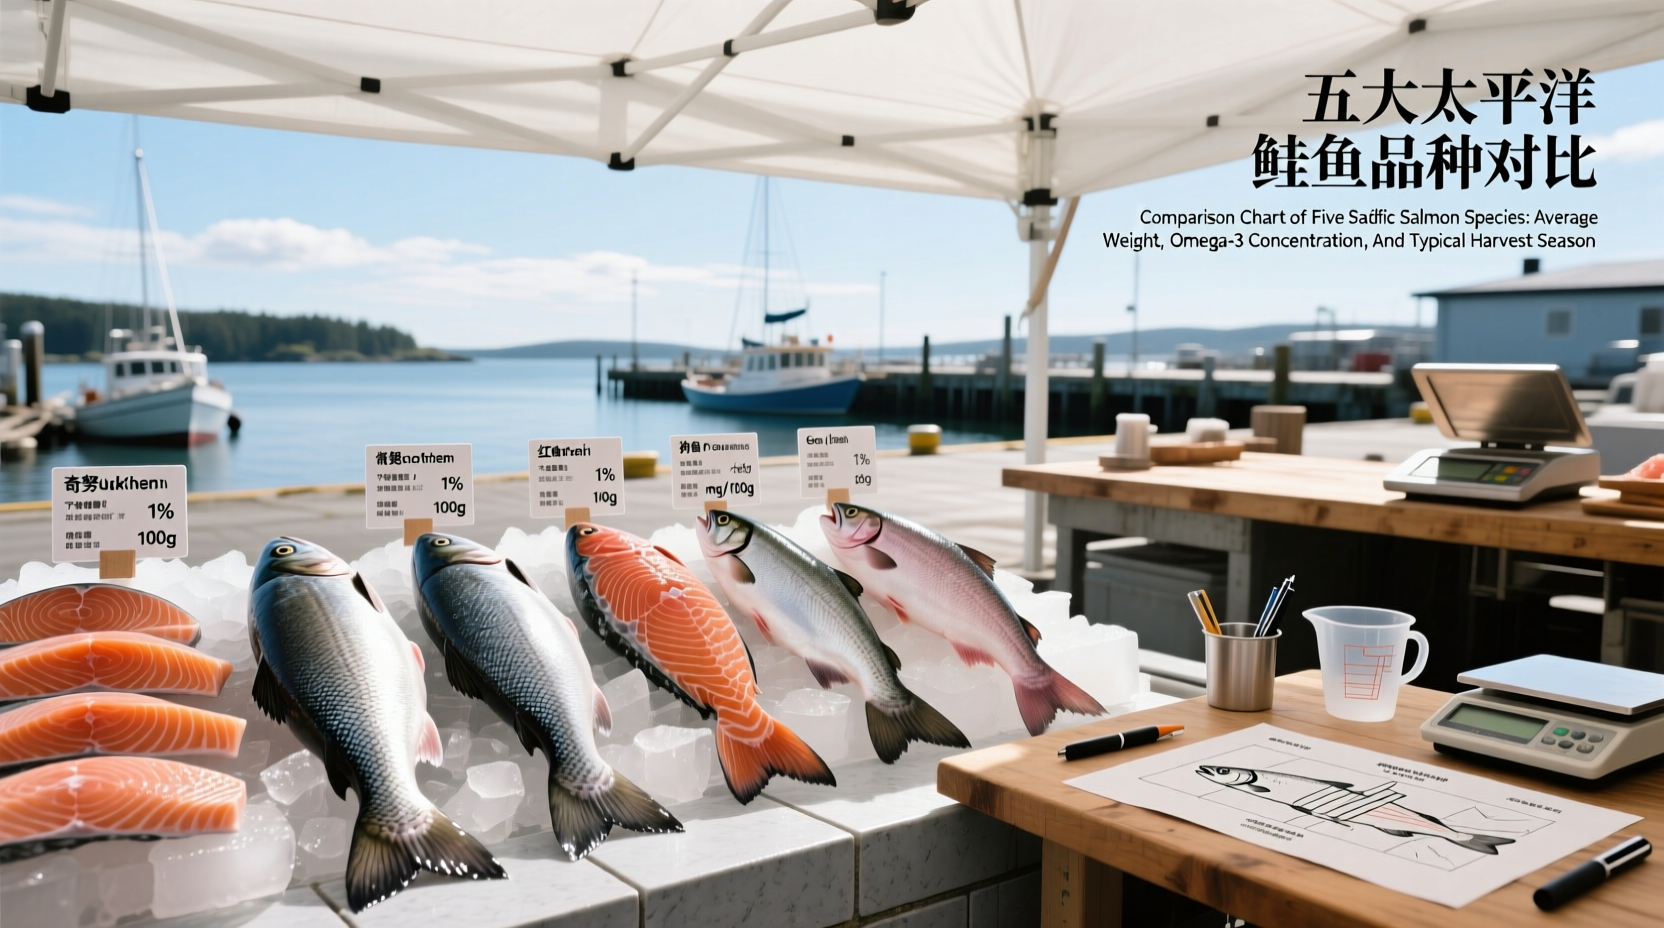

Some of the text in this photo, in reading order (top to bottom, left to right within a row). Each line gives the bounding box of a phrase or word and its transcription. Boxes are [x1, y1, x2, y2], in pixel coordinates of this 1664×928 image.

[595, 467, 615, 482] 1%
[441, 476, 464, 491] 1%
[148, 503, 175, 519] 1%
[433, 501, 466, 517] 100g
[138, 530, 176, 549] 100g
